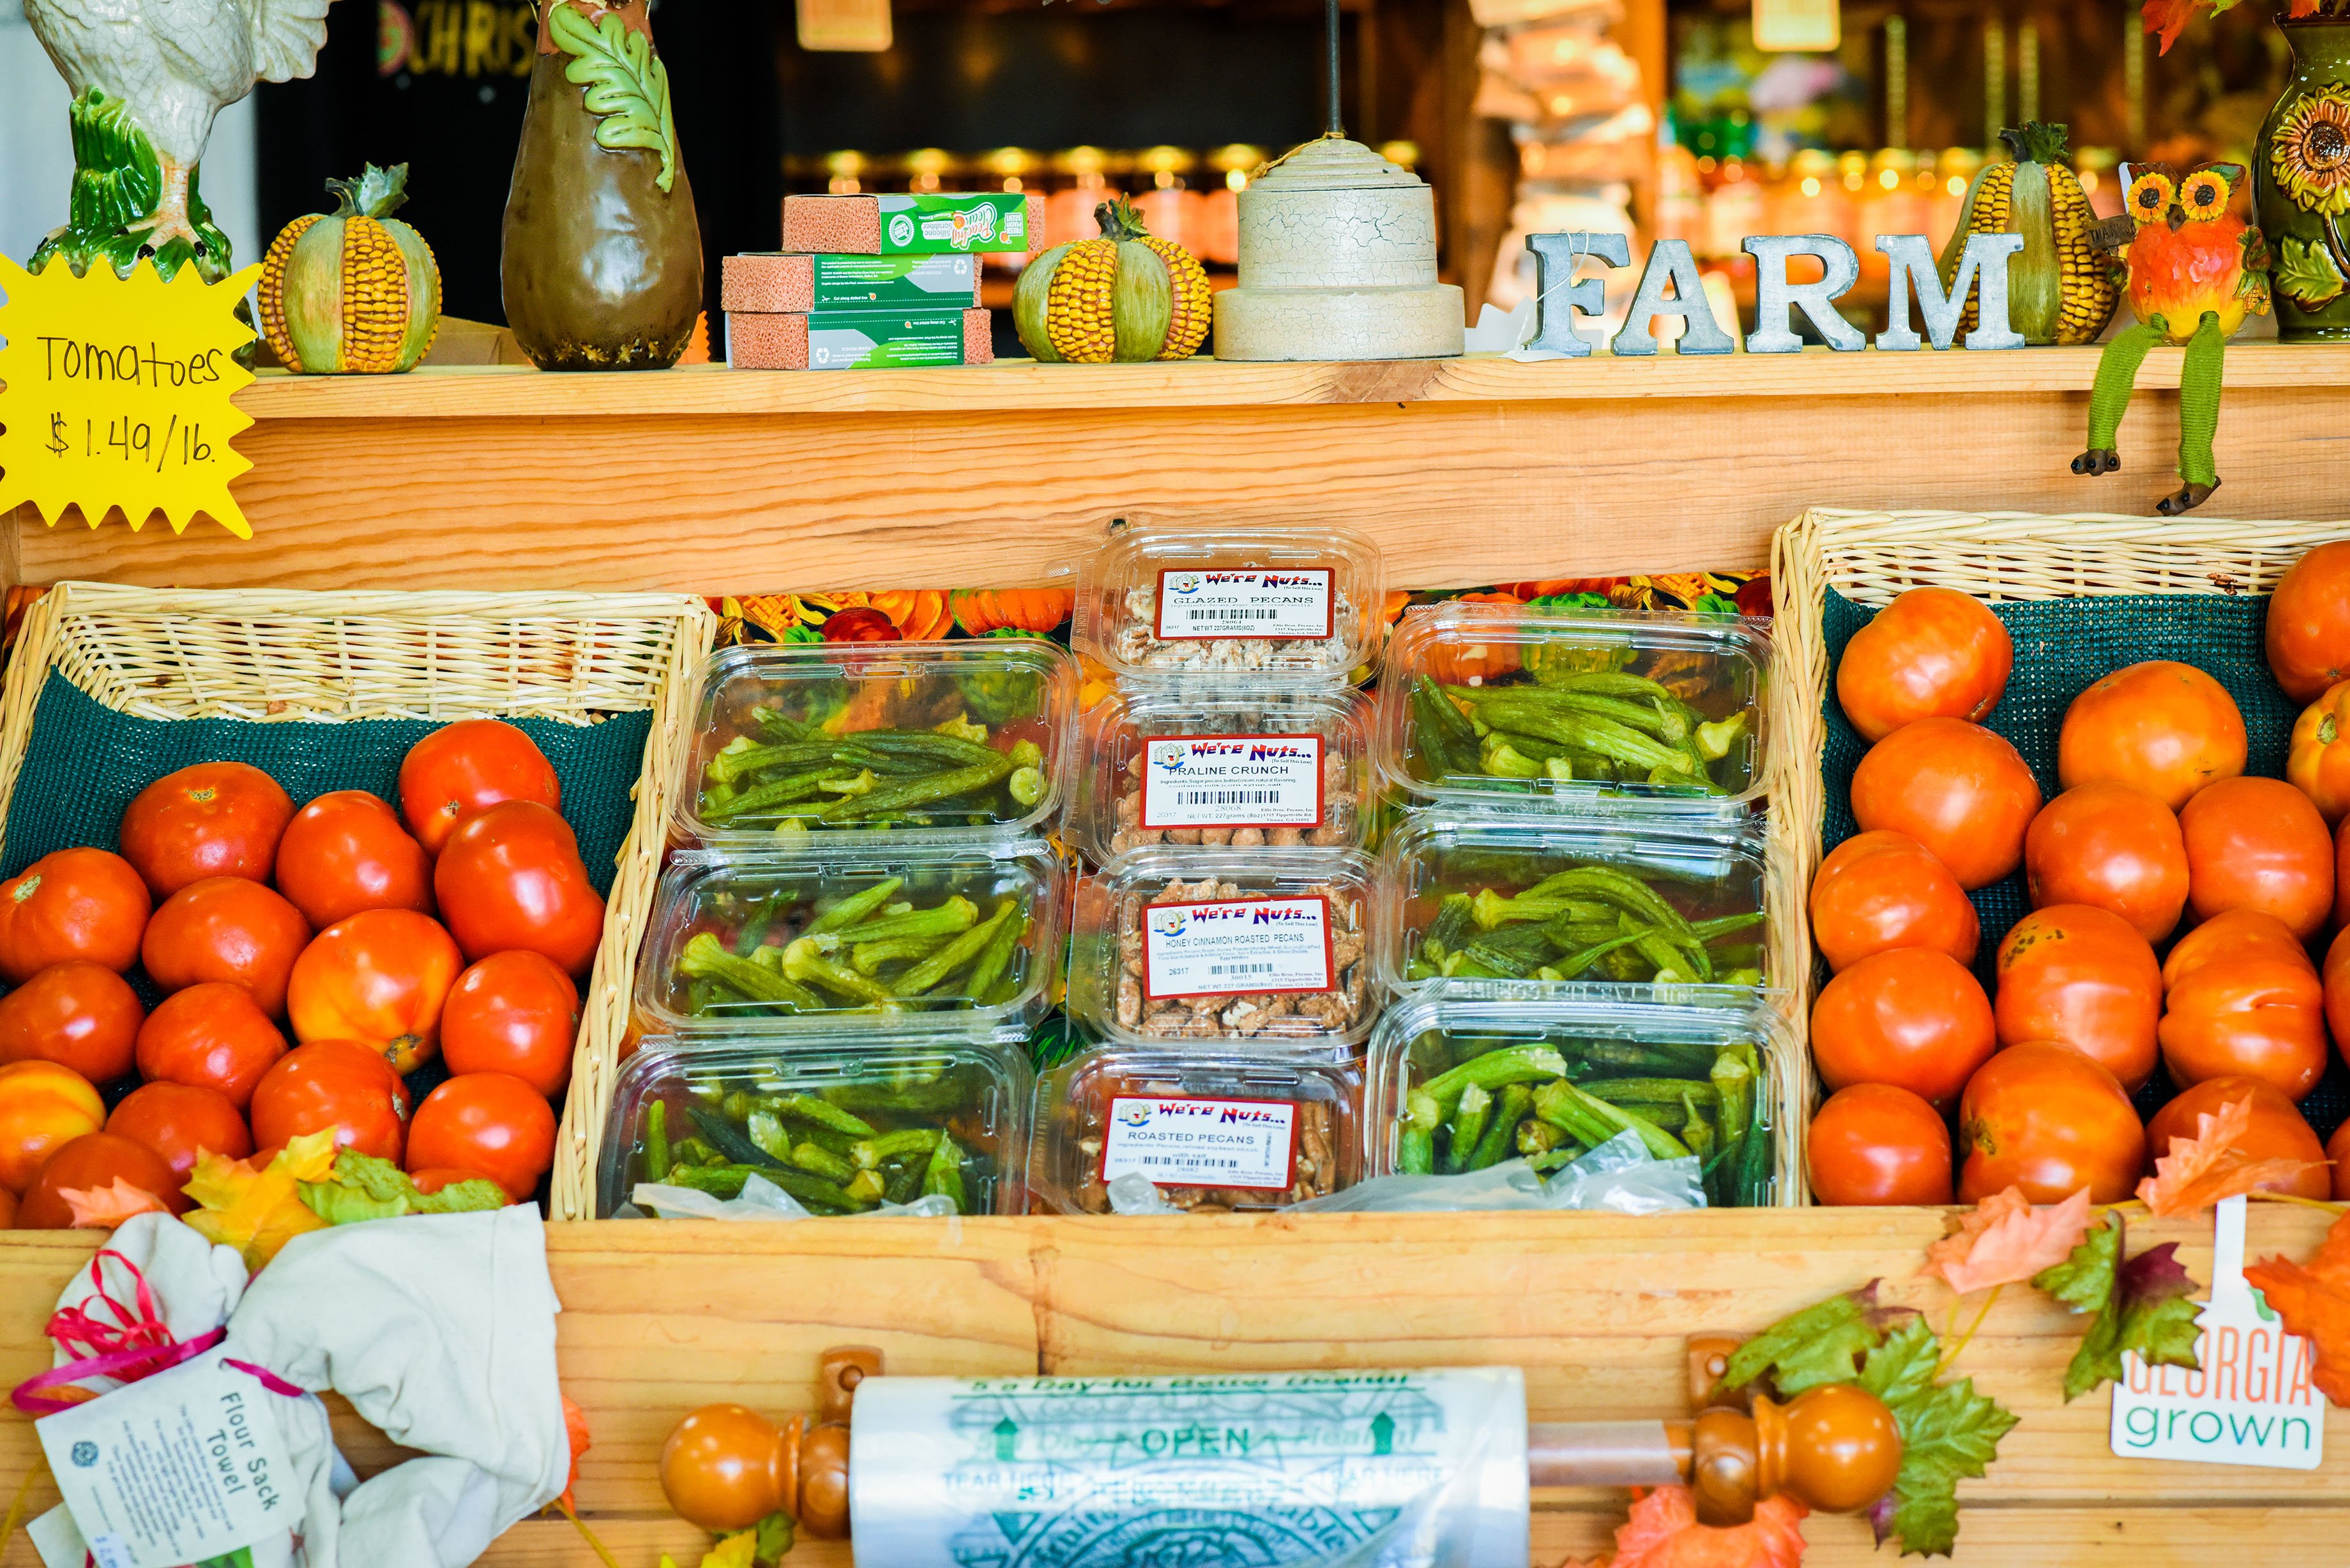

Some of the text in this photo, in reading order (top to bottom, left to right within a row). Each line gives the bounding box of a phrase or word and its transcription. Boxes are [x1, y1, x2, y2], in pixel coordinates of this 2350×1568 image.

[1525, 232, 2024, 357] FARM
[37, 337, 223, 387] Tomatoes
[1206, 573, 1323, 588] We're Nuts...
[1191, 742, 1311, 762] We're Nuts...
[1169, 766, 1288, 775] PRALINE CRUNCH
[1192, 907, 1316, 925] We're Nuts...
[1166, 934, 1304, 948] HONEY CINNAMON ROASTED PECANS
[1159, 1103, 1214, 1117] We're
[1128, 1132, 1254, 1144] ROASTED PECANS
[2126, 1406, 2310, 1451] grown
[220, 1392, 280, 1511] Flour Sack
[1141, 1428, 1248, 1456] OPEN
[207, 1429, 247, 1495] Towel
